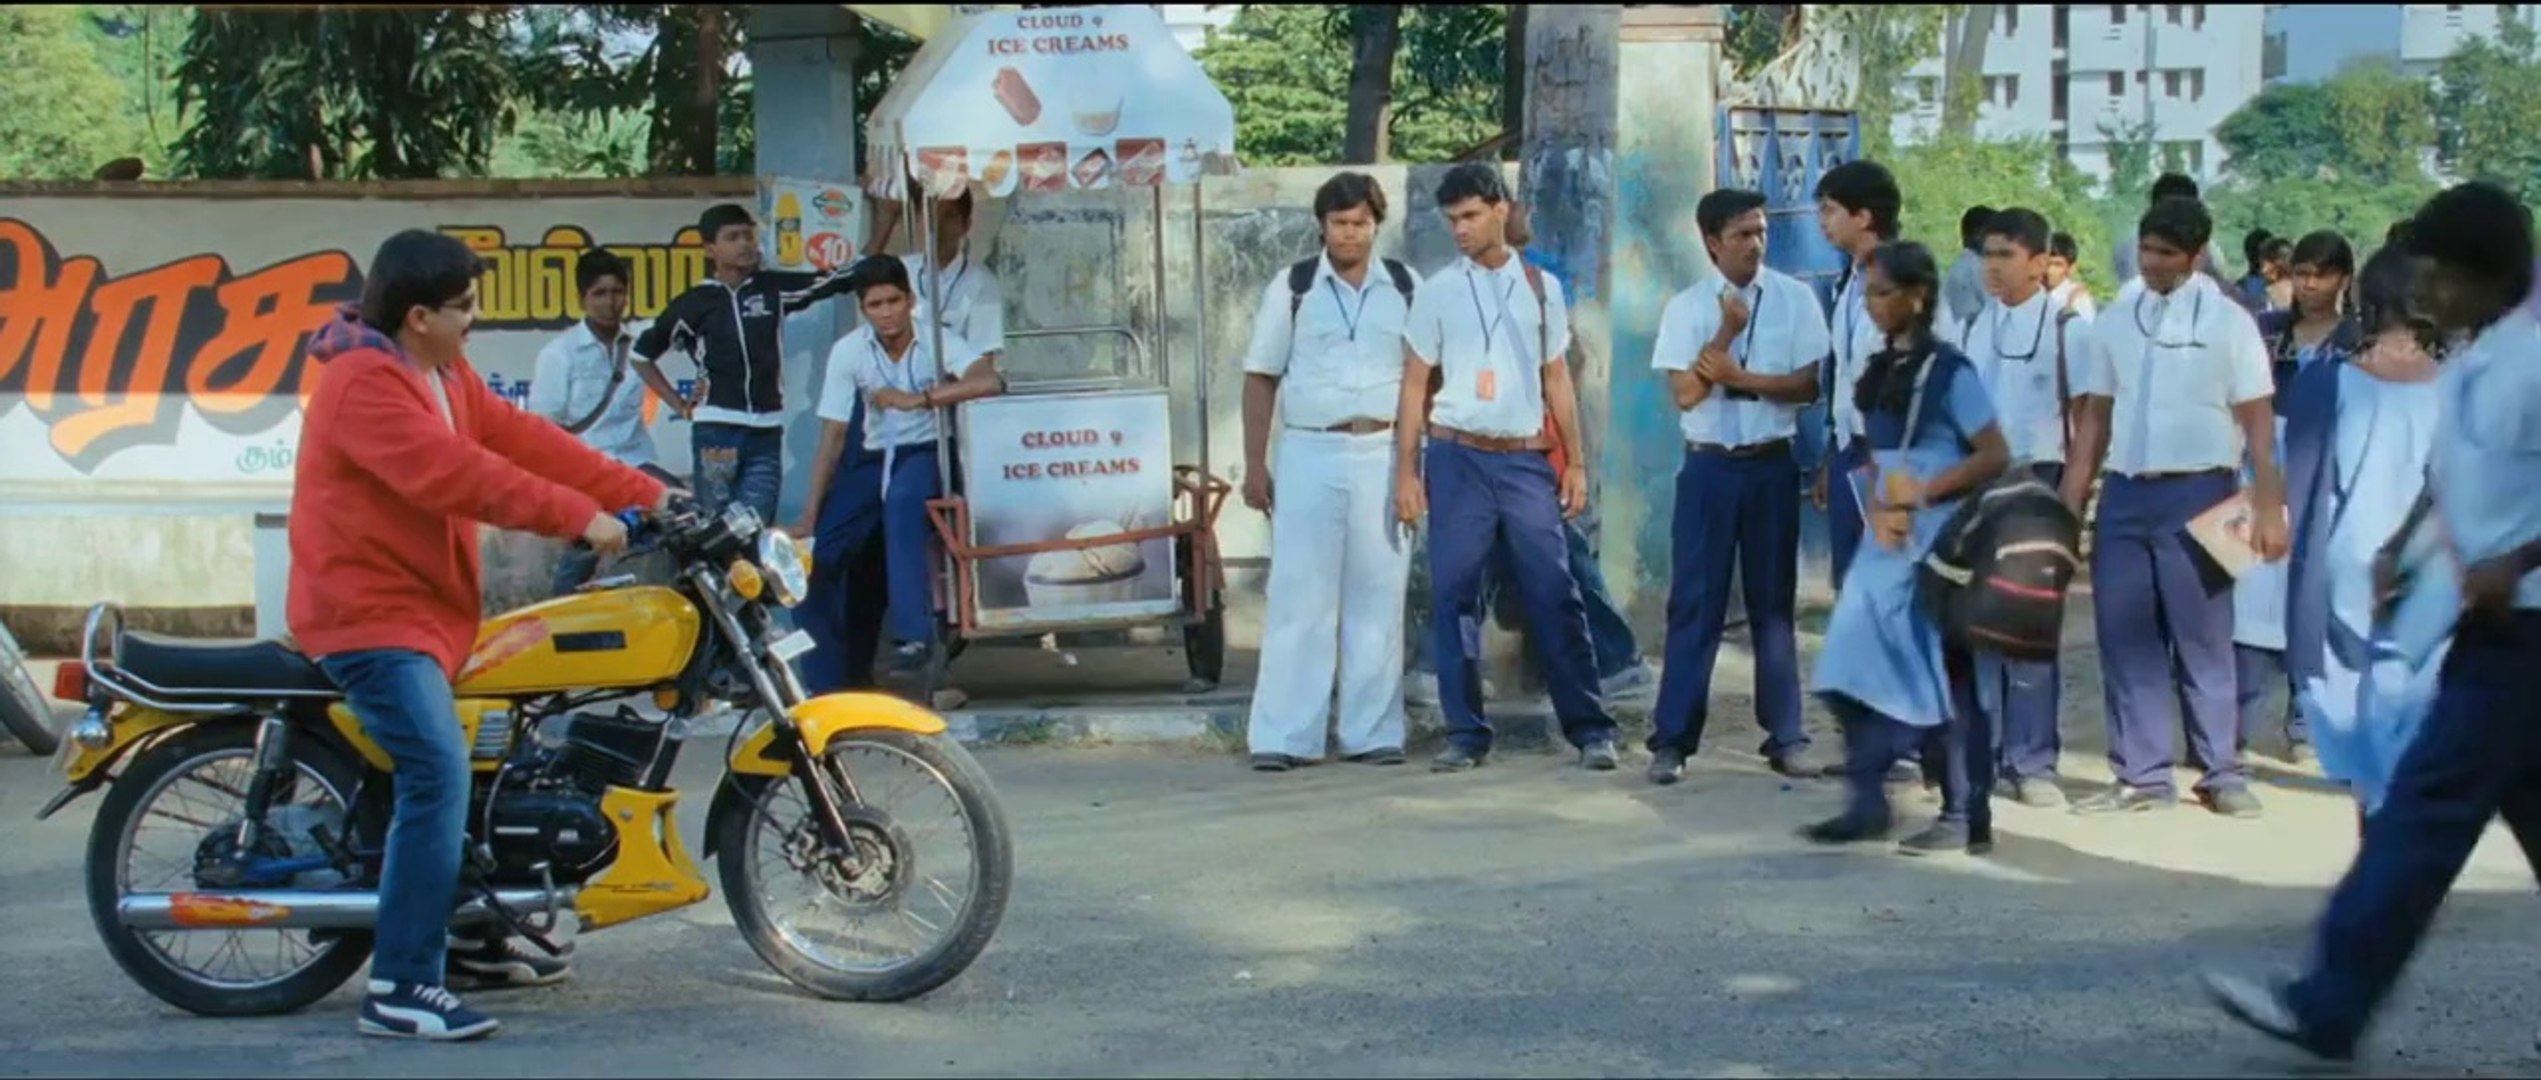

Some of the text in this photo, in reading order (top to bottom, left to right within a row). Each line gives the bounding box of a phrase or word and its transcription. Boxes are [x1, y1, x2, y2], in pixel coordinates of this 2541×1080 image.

[1017, 15, 1103, 29] CLOUD 9
[987, 34, 1129, 55] ICE CREAMS
[1021, 430, 1123, 448] CLOUD 9
[1003, 458, 1141, 480] ICE CREAMS
